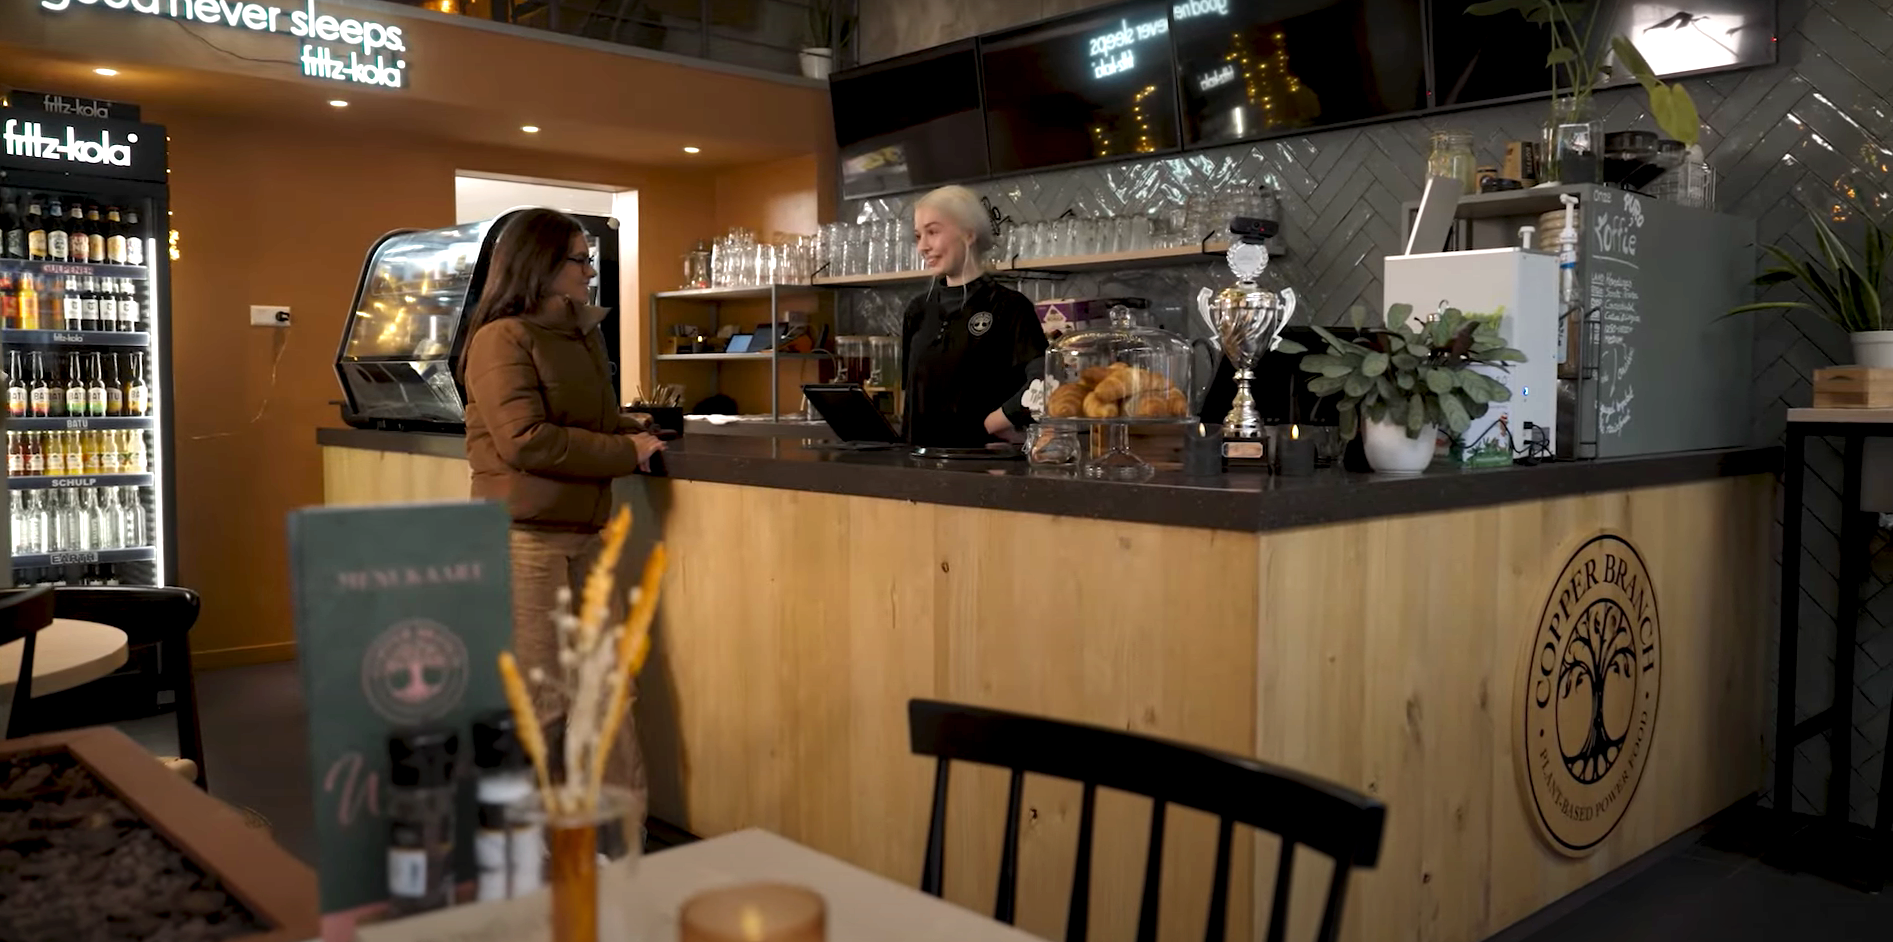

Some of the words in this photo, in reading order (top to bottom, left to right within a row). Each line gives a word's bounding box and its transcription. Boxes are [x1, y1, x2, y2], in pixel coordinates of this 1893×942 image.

[170, 0, 281, 32] never
[301, 45, 402, 87] fritz-kola
[43, 94, 109, 119] fritz-kola
[3, 119, 131, 166] fritz-kola
[66, 419, 89, 429] BATU
[51, 478, 97, 487] SCHULP
[1536, 558, 1599, 709] COPPER
[1603, 554, 1655, 673] BRANCH
